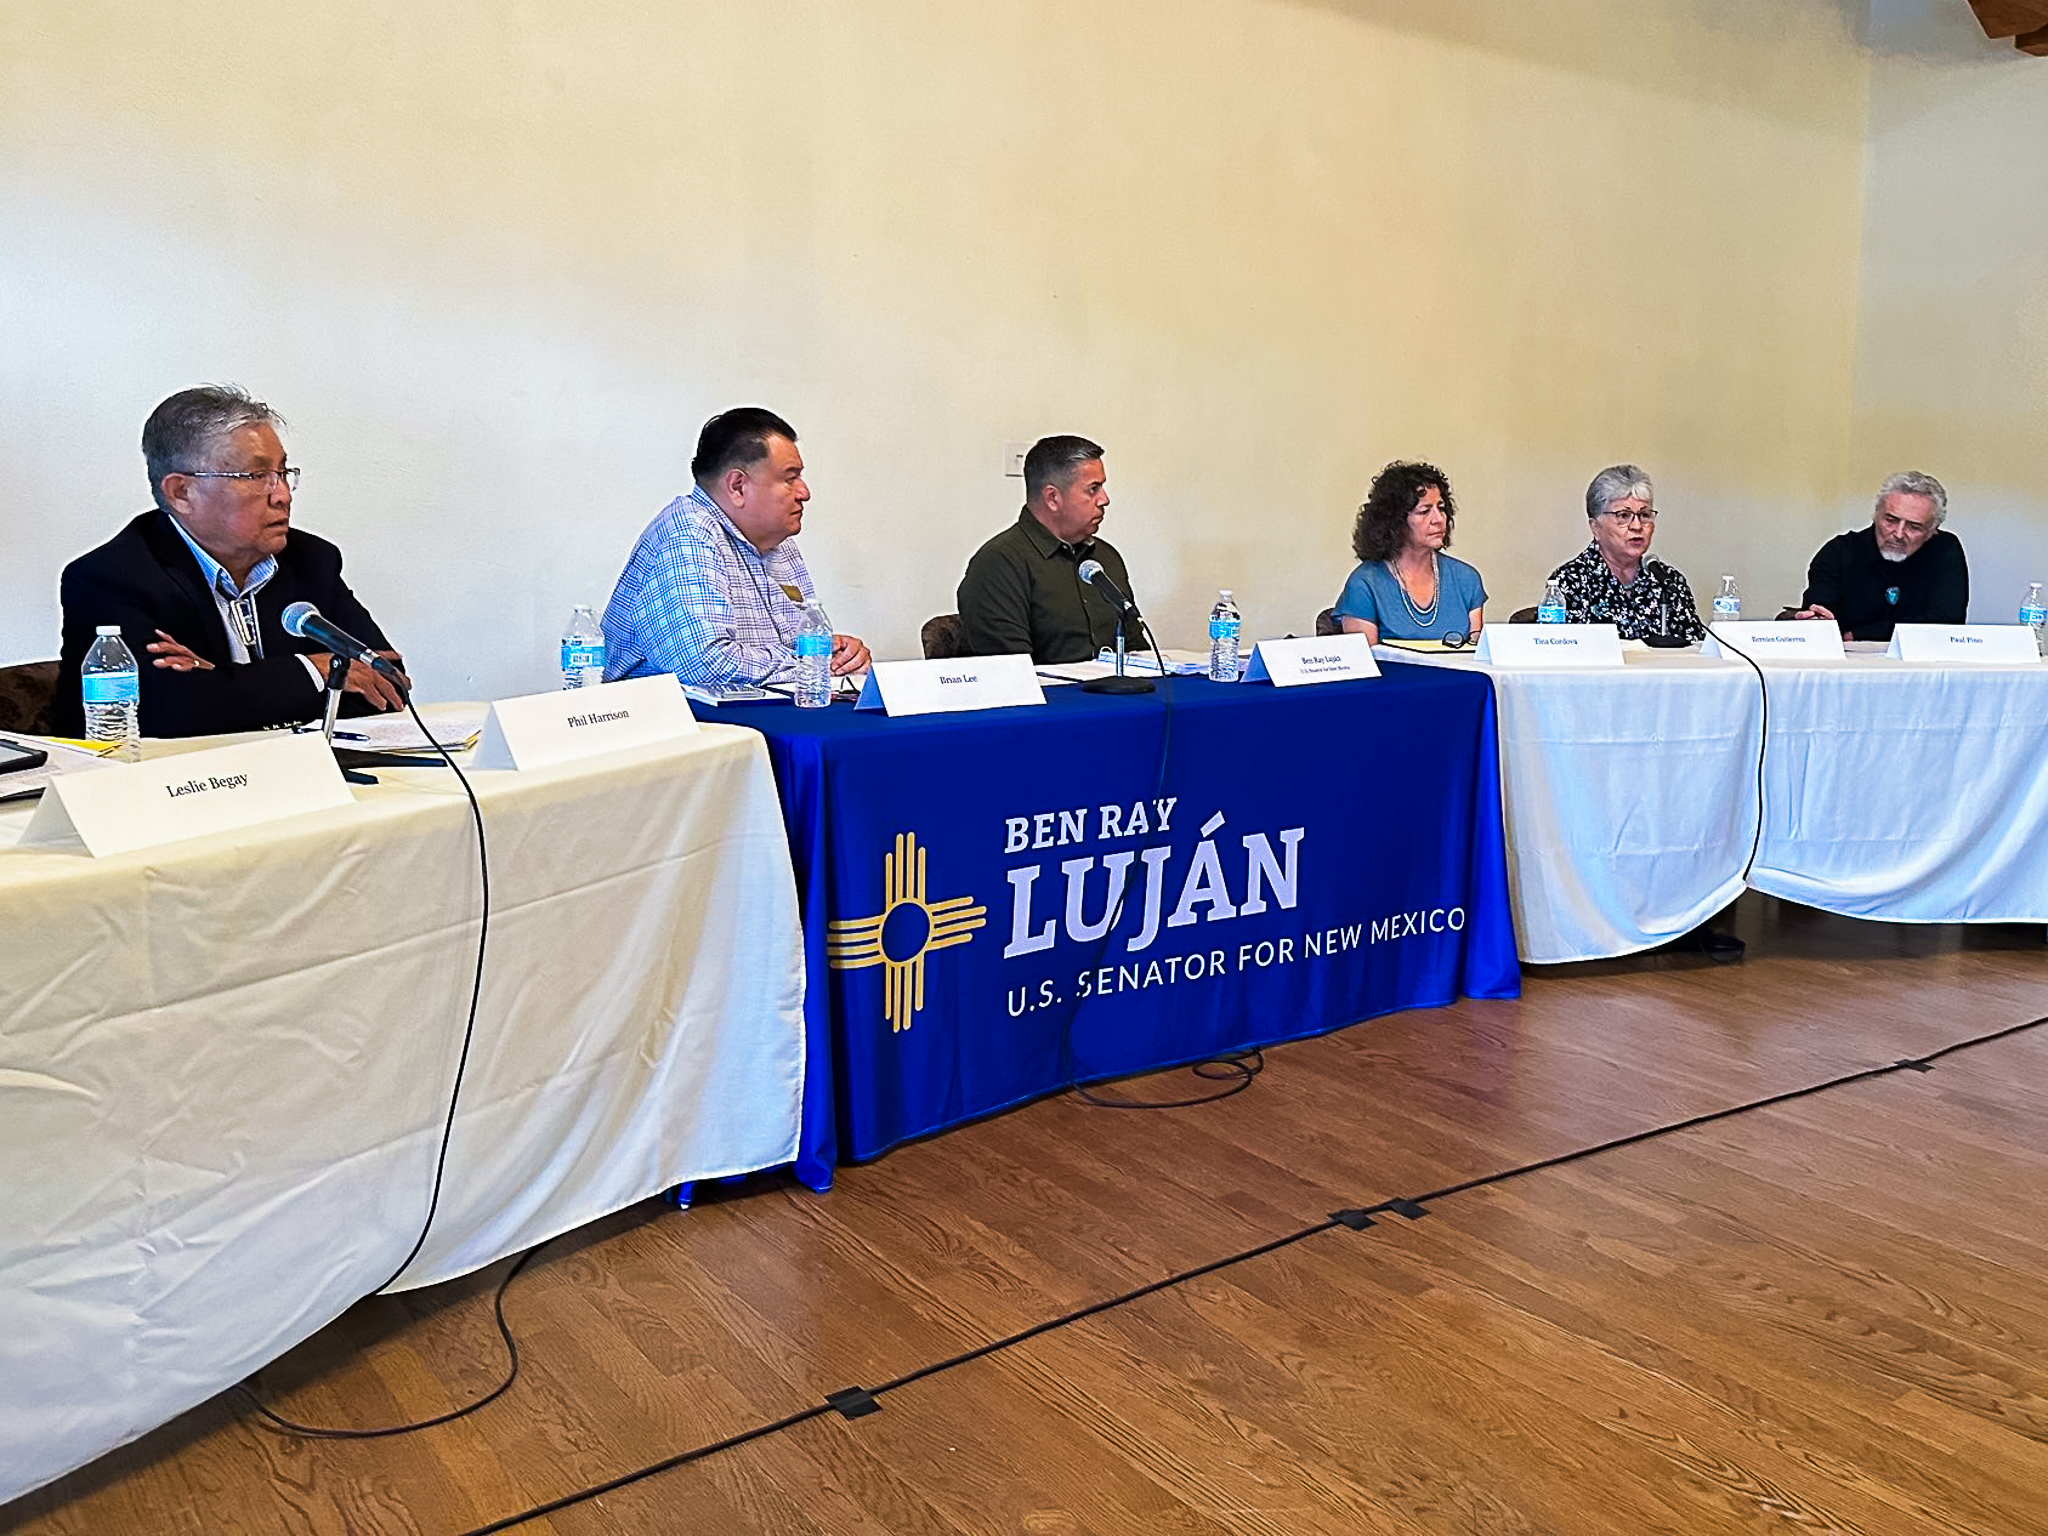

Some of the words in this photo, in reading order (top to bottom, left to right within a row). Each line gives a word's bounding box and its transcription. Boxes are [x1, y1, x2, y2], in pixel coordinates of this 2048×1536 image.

[1532, 637, 1549, 645] Tina
[1301, 657, 1313, 665] Ben
[1313, 656, 1325, 665] Ray
[939, 675, 962, 684] Brian
[962, 674, 978, 683] Lee
[567, 715, 588, 727] Phil
[588, 710, 630, 724] Harrison
[166, 780, 208, 797] Leslie
[208, 774, 248, 790] Begay
[1004, 808, 1088, 854] BEN
[1098, 797, 1177, 840] RAY
[1003, 810, 1305, 960] LUJÁN
[1008, 979, 1062, 1017] U.S.
[1076, 950, 1226, 998] SENATOR
[1238, 938, 1294, 972] FOR
[1305, 923, 1362, 958] NEW
[1371, 907, 1465, 945] MEXICO
